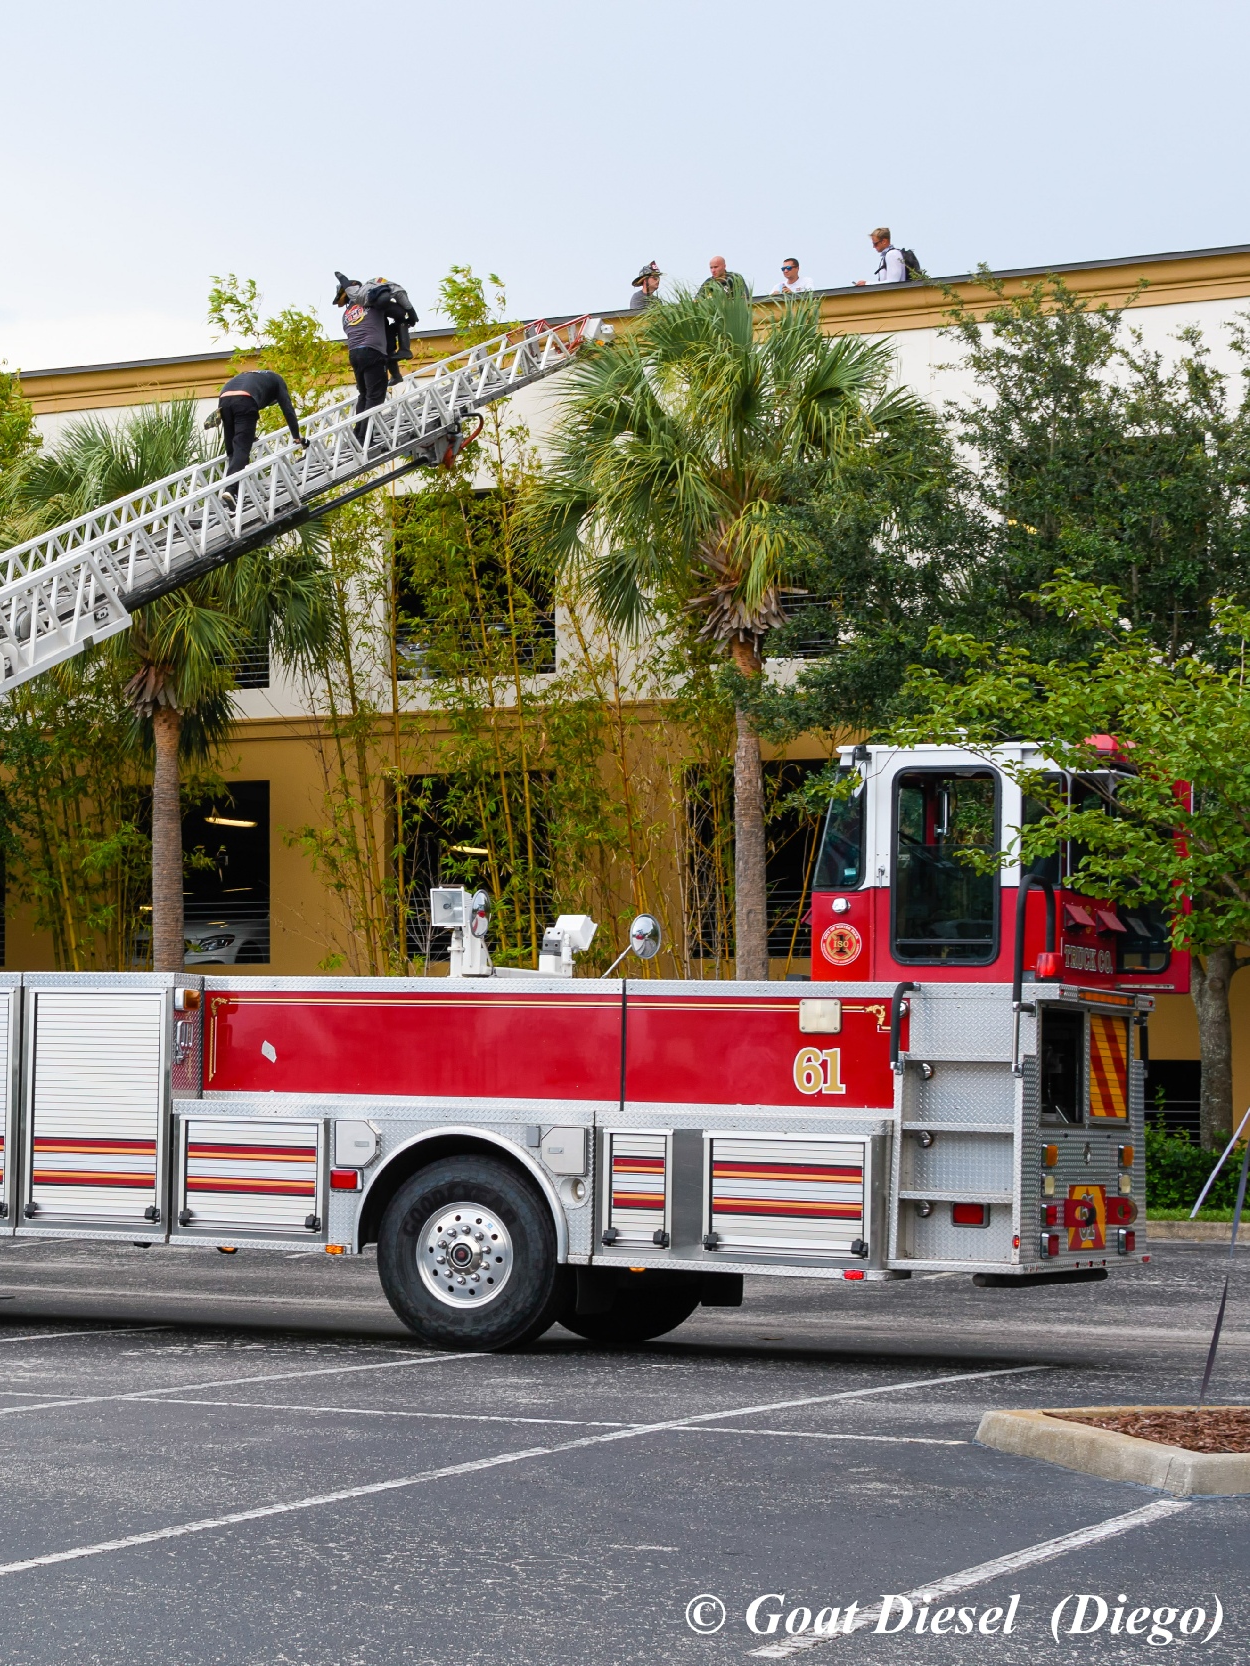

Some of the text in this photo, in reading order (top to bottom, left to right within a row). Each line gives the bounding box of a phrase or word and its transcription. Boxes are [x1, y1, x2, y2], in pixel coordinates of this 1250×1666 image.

[1064, 944, 1114, 974] TRUCK CO.
[793, 1046, 846, 1095] 61
